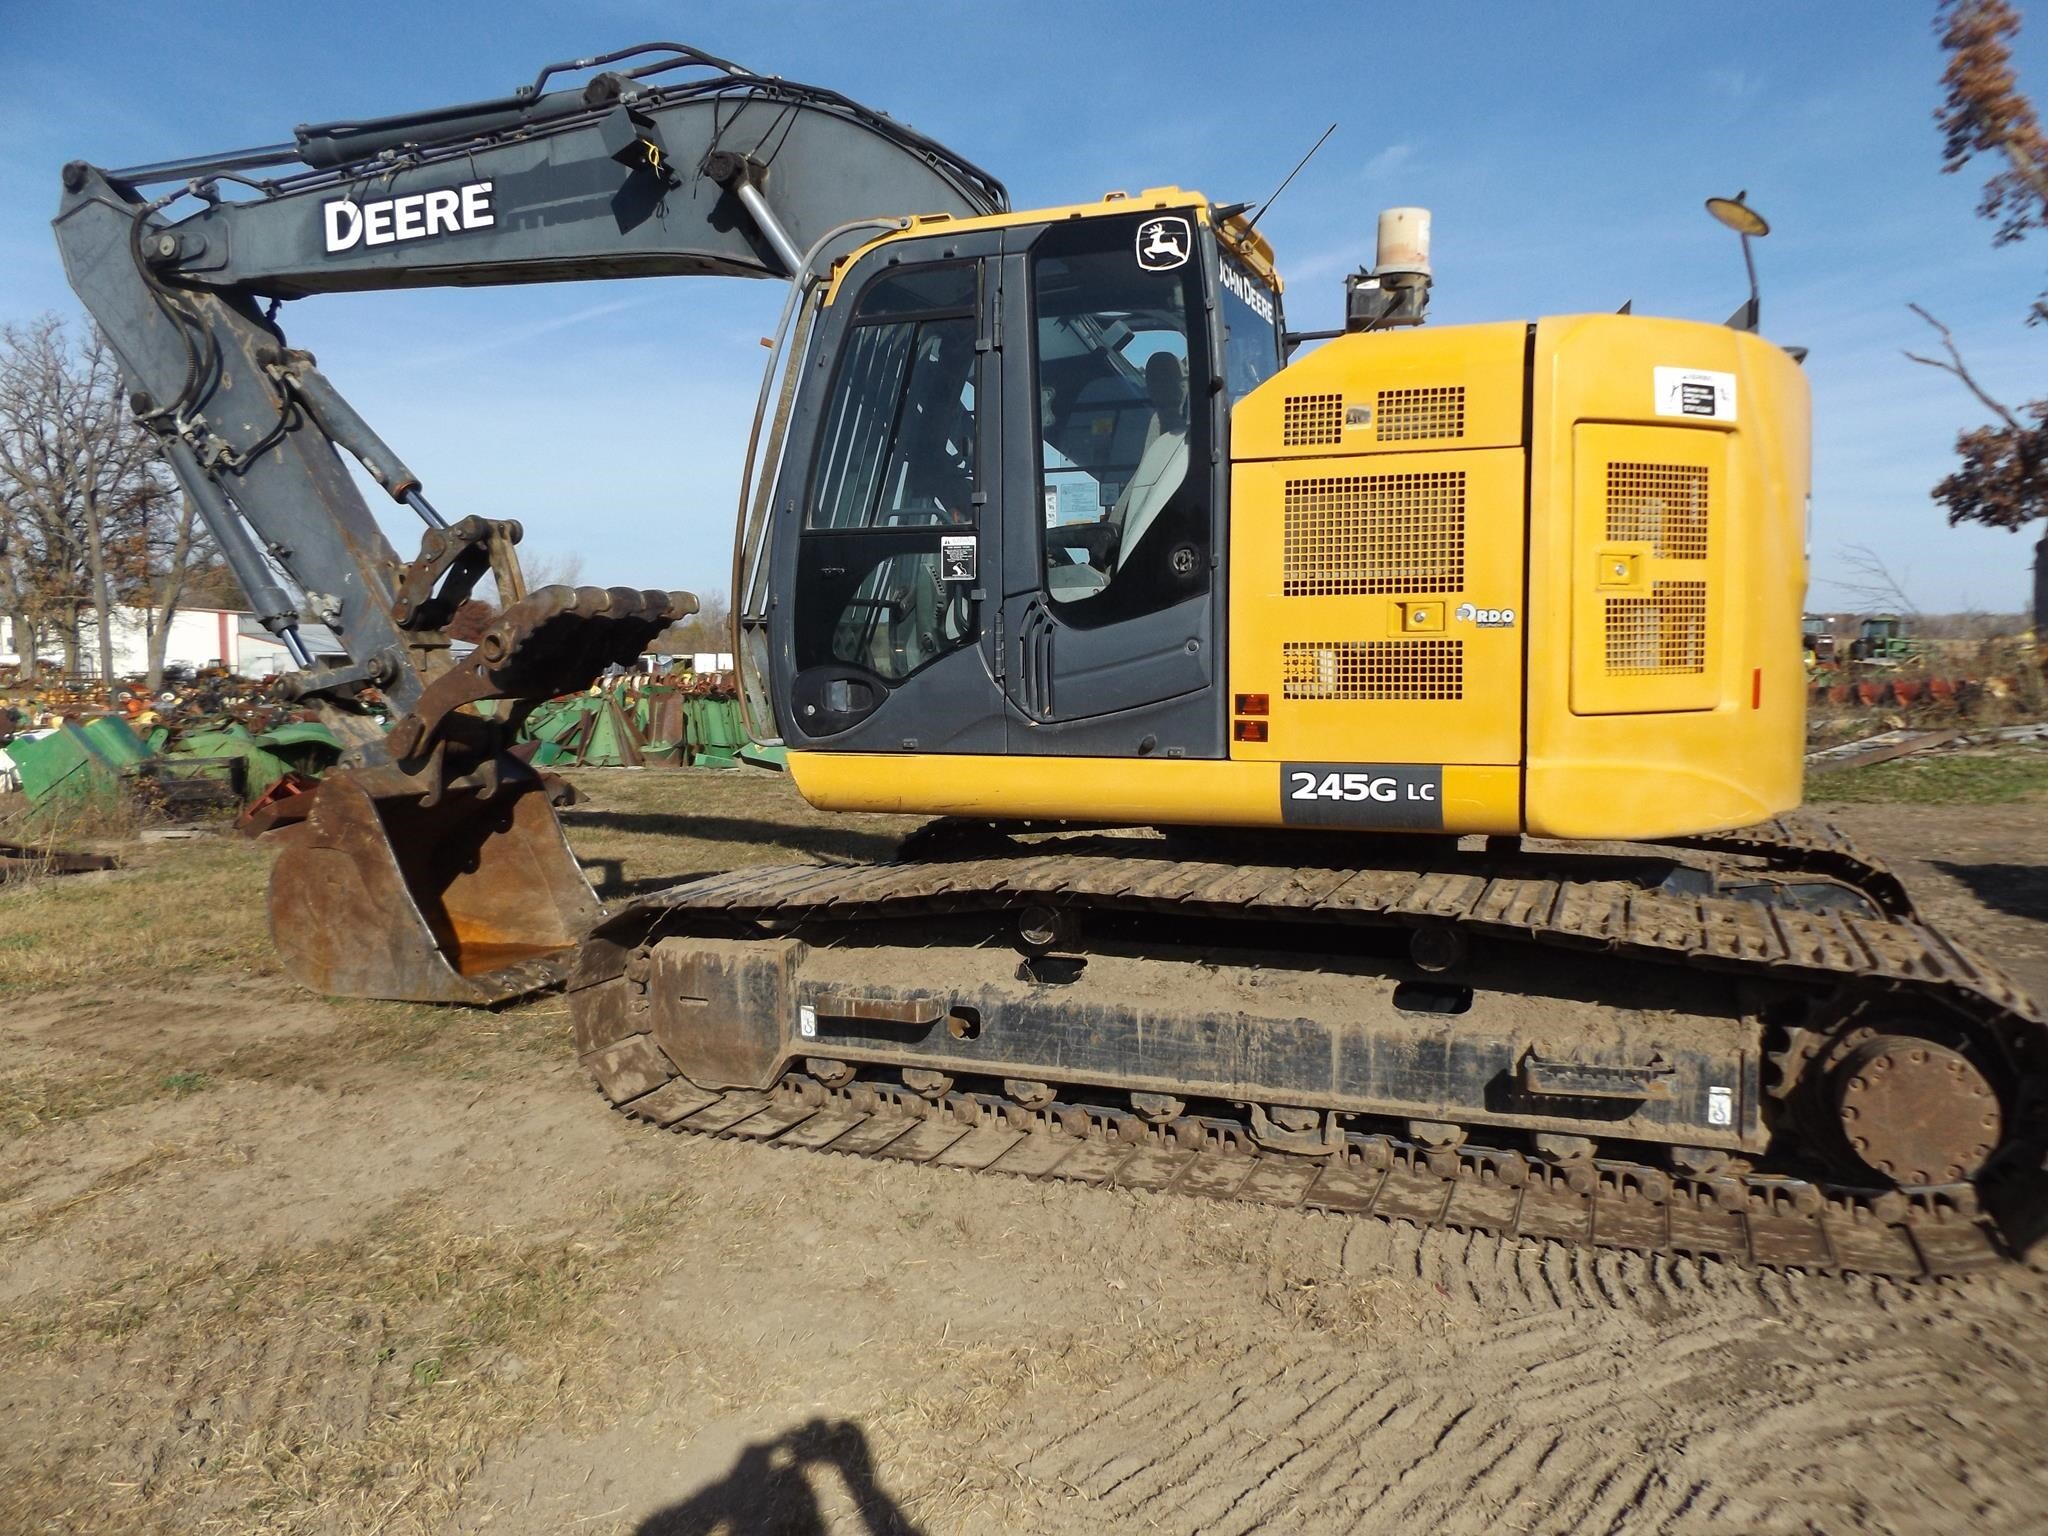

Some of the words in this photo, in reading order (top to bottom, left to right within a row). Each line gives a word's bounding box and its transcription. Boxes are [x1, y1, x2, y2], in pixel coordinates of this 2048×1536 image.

[324, 182, 495, 252] DEERE
[1219, 255, 1243, 300] JOHN
[1243, 276, 1274, 325] DEERE
[1476, 608, 1515, 623] RDO
[1291, 772, 1398, 802] 245G
[1407, 783, 1436, 801] LC
